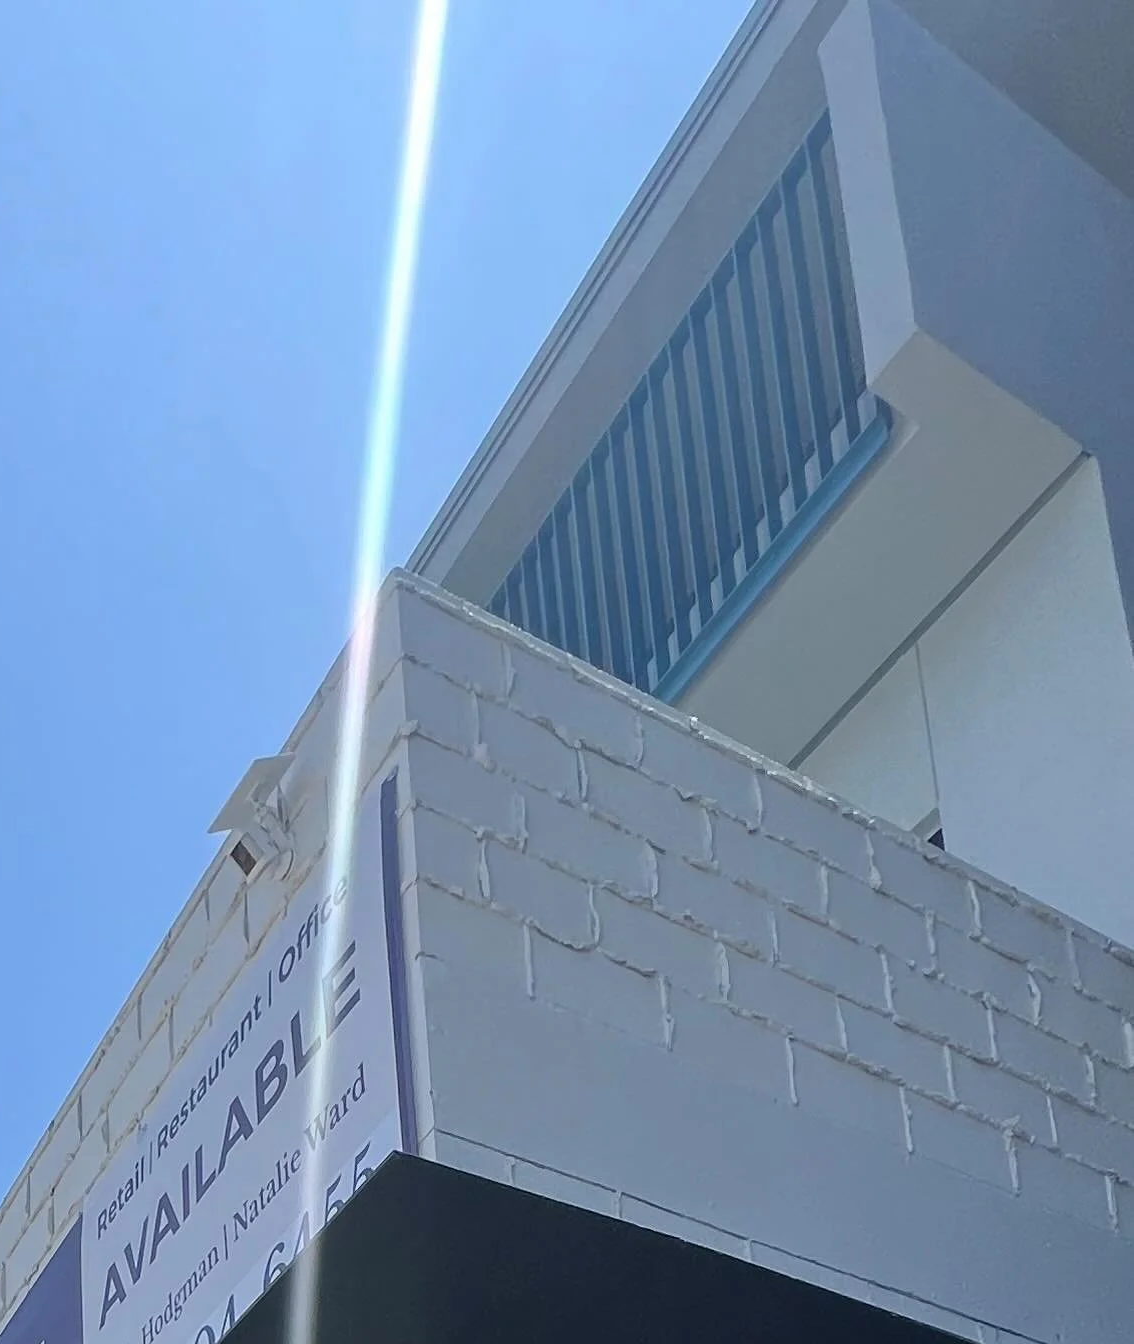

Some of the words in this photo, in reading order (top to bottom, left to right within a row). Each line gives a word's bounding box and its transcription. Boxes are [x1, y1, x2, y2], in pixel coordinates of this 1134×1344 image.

[97, 1156, 145, 1240] Retail
[157, 992, 262, 1159] Restaurant
[279, 875, 348, 984] Office
[99, 940, 361, 1331] AVAILABLE
[233, 1149, 301, 1242] Natalie
[303, 1062, 366, 1153] Ward
